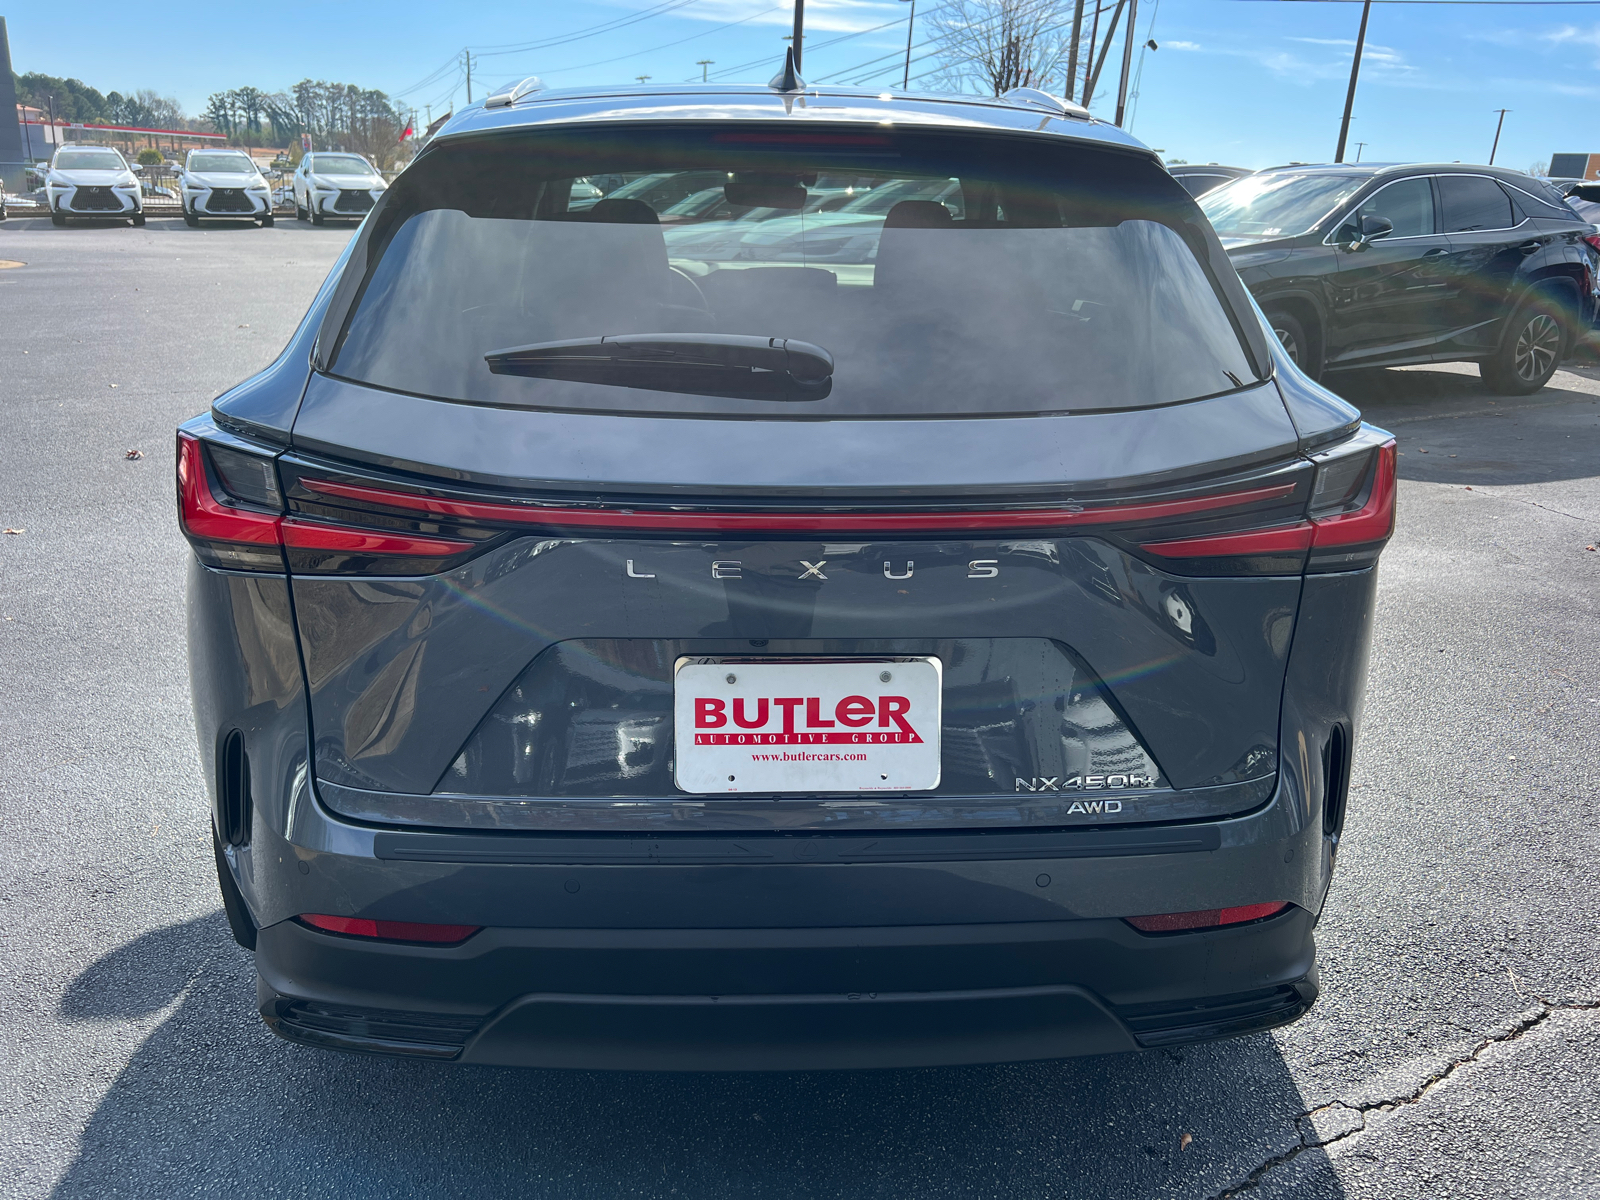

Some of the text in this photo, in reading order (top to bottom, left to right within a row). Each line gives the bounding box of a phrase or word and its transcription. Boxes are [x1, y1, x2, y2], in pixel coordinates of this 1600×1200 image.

[626, 559, 999, 580] LEXUS
[695, 733, 915, 744] AUTOMOTIVE GROUP
[751, 751, 867, 761] www.butlercars.com
[1066, 801, 1122, 815] AWD
